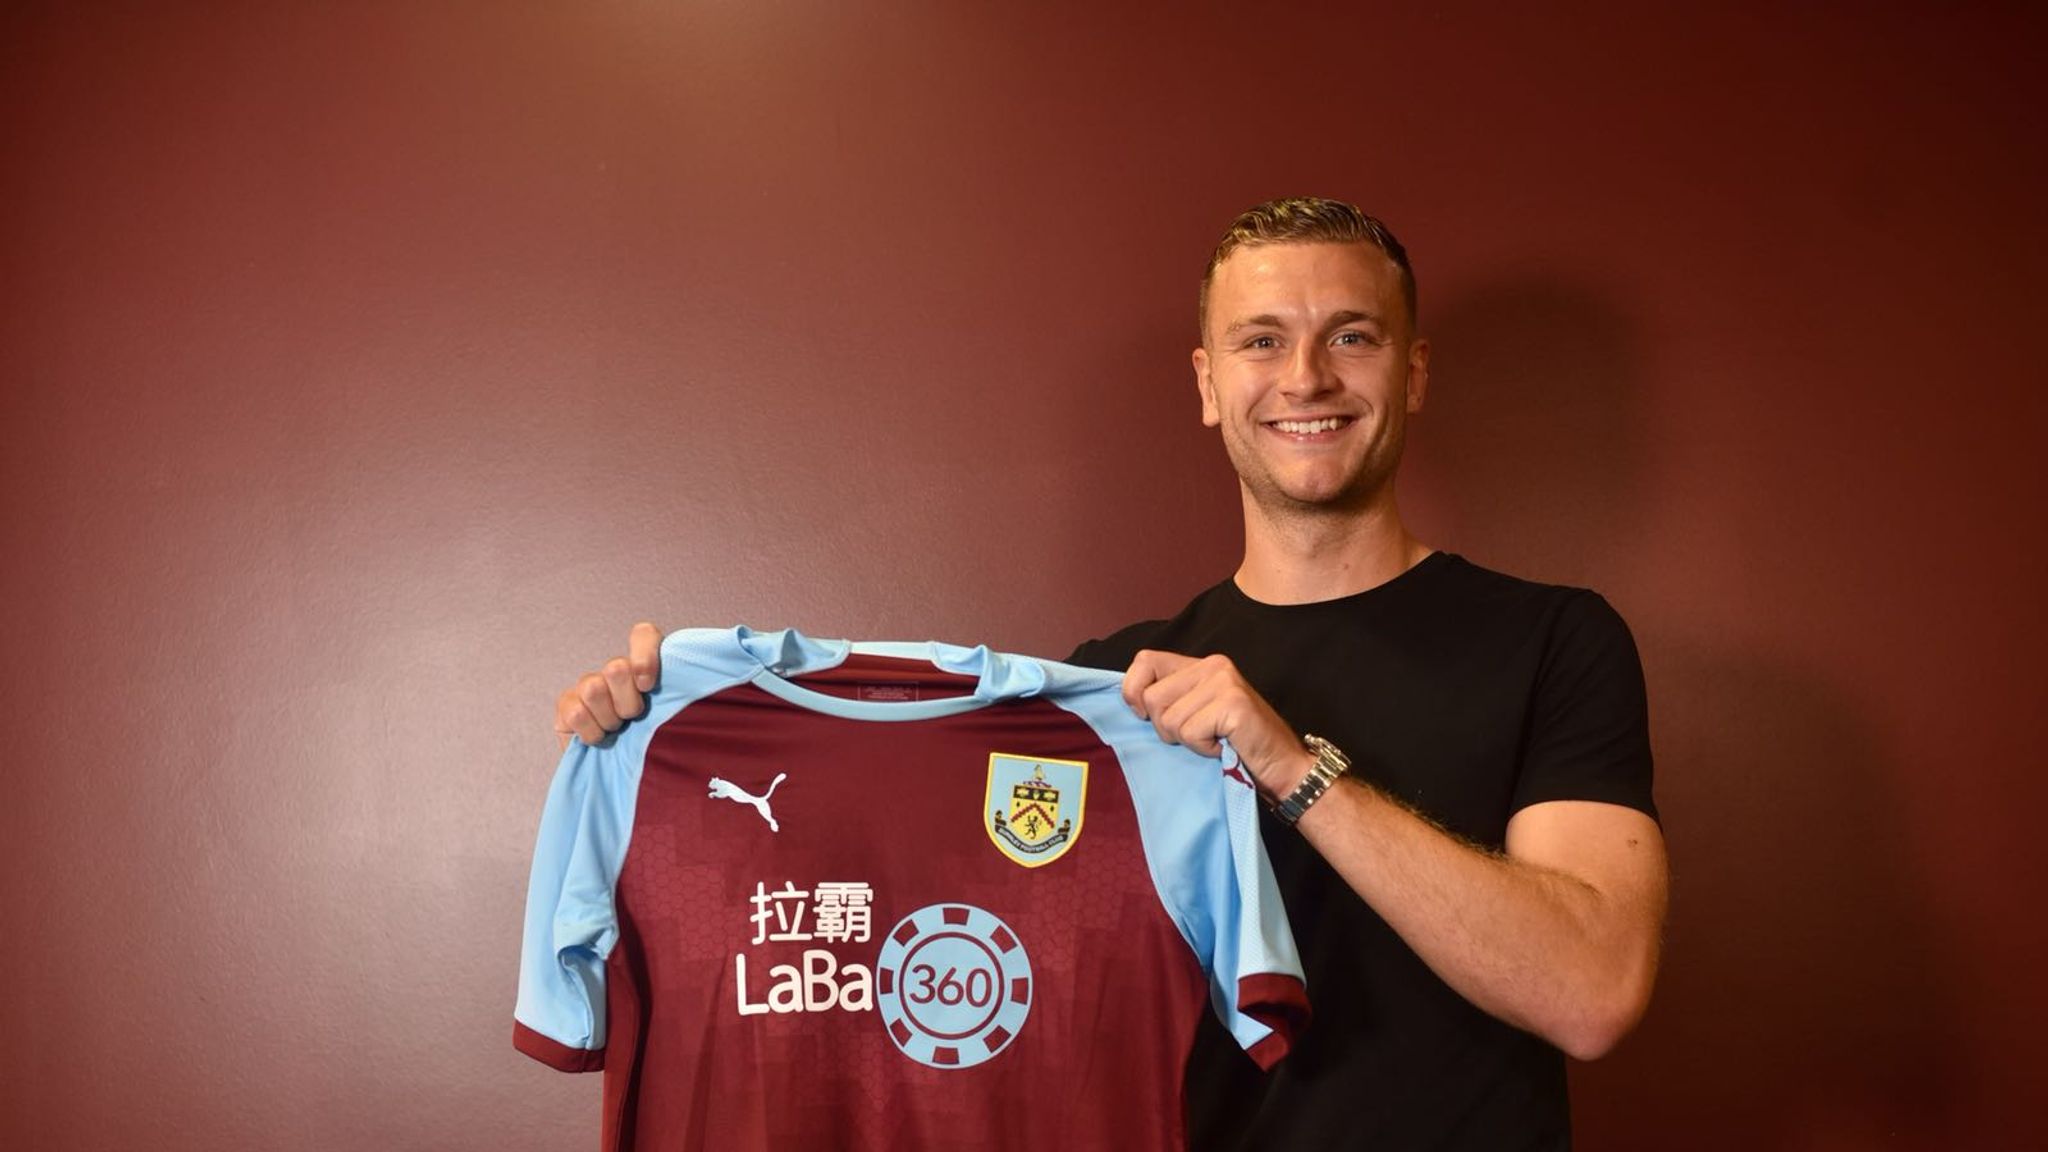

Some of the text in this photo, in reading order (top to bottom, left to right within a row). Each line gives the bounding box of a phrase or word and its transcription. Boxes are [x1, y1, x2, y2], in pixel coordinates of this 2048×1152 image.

[750, 881, 873, 945] 拉霸
[736, 949, 873, 1015] LaBa
[909, 964, 992, 1008] 360
